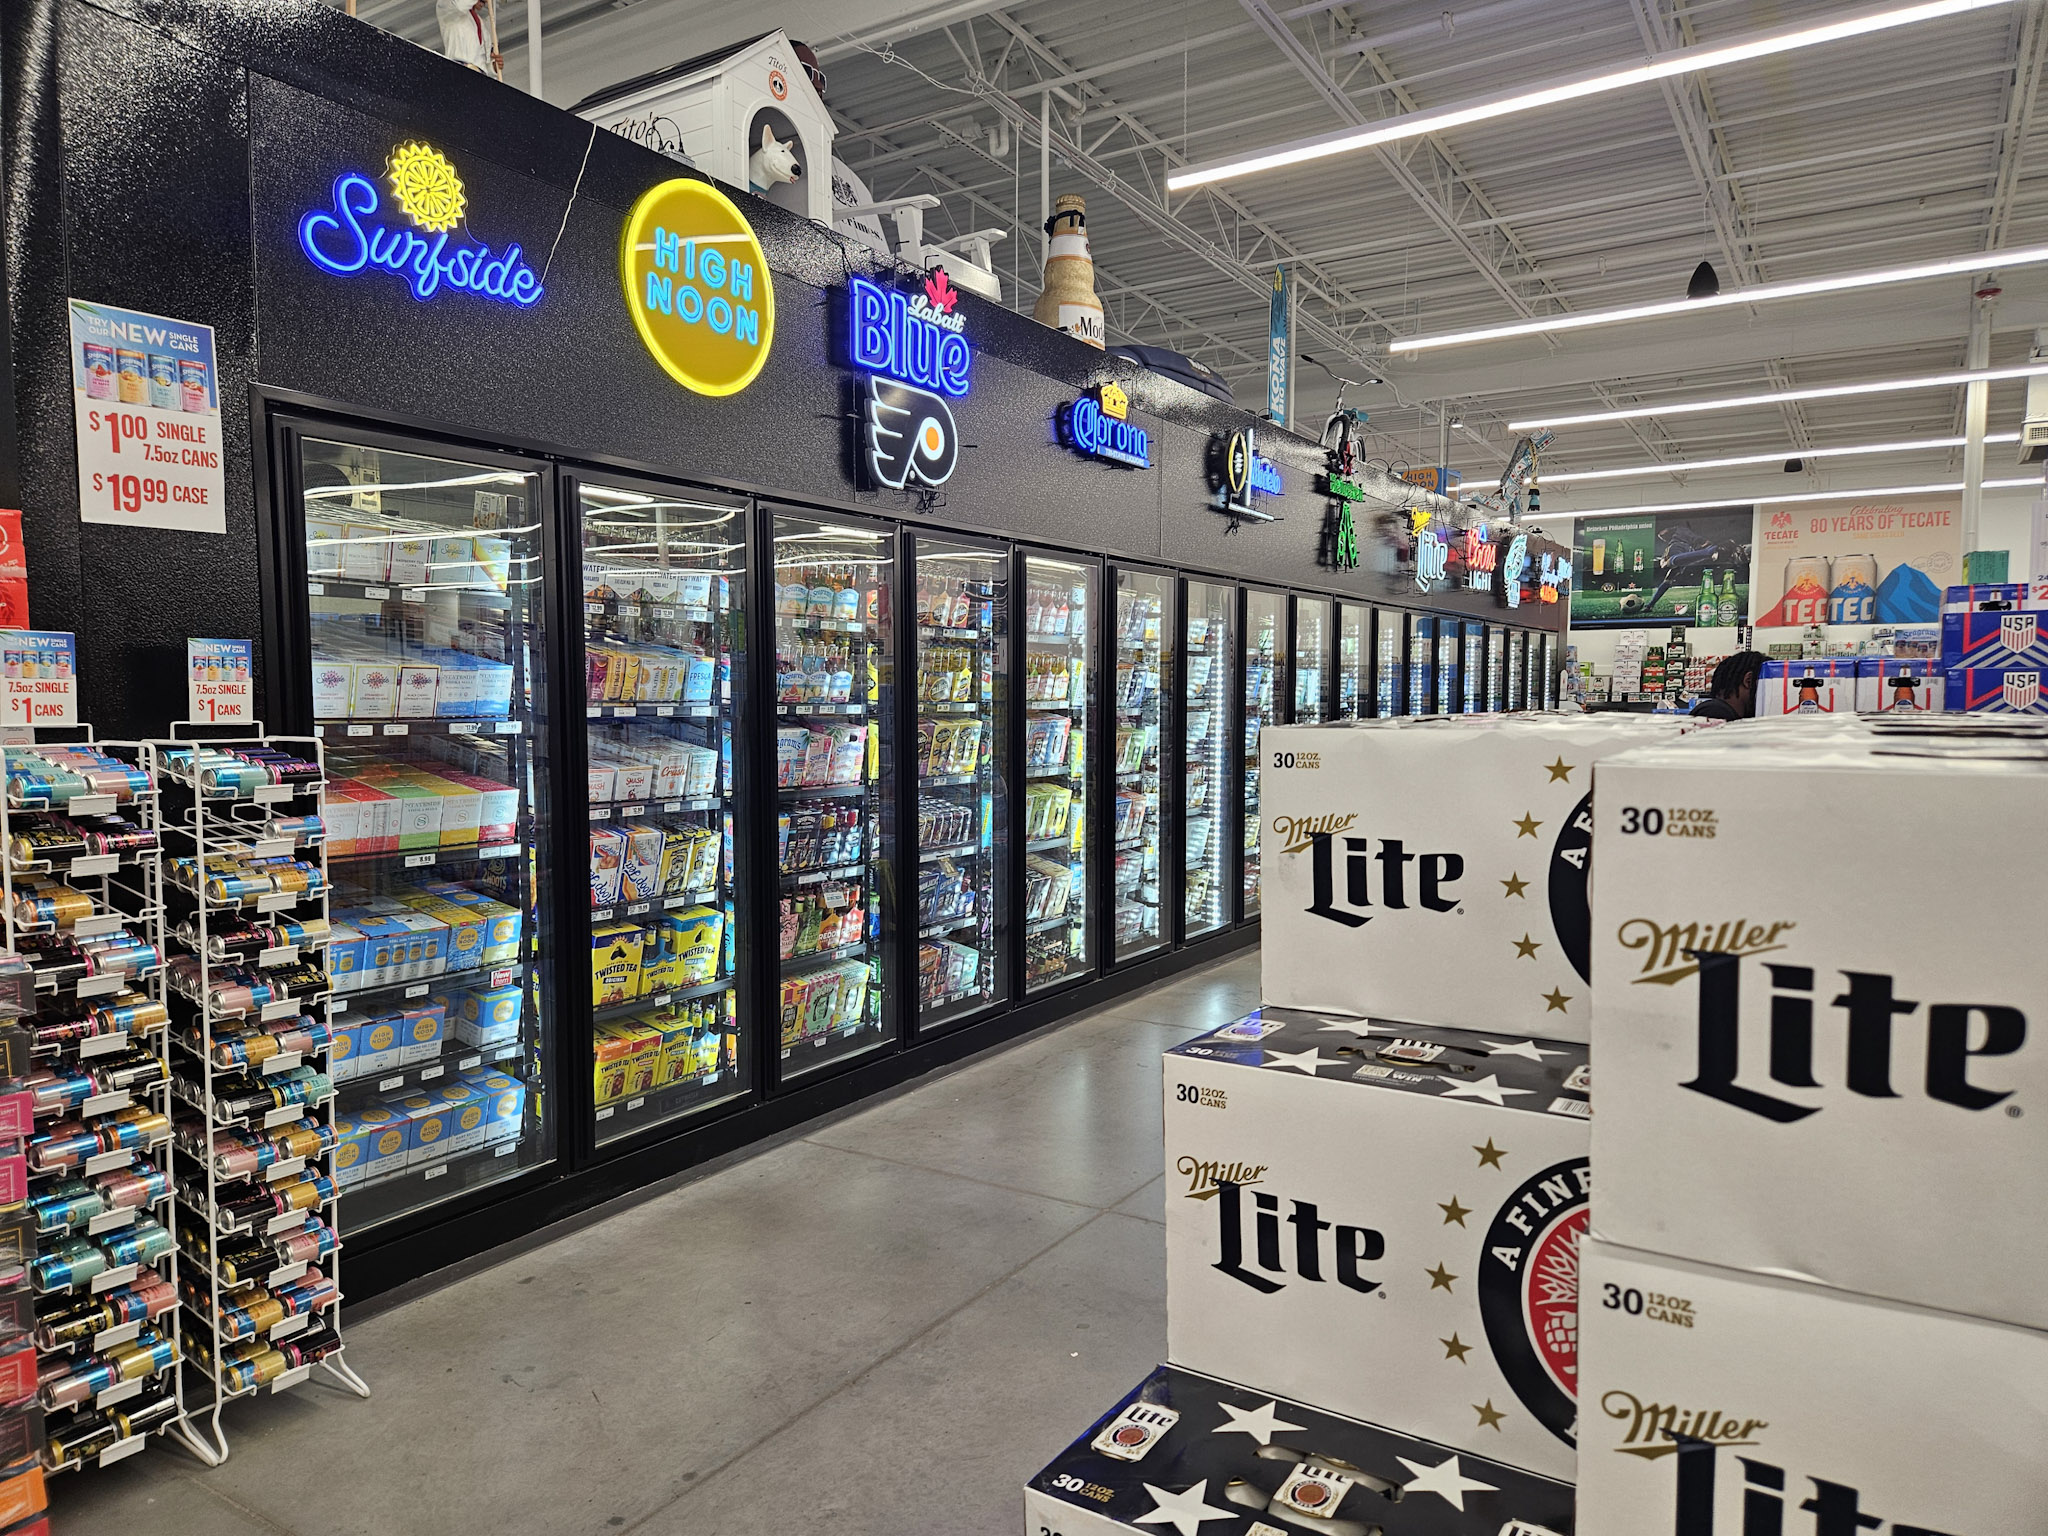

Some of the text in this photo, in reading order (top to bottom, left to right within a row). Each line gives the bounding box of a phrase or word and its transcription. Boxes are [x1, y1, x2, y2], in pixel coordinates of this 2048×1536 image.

[304, 176, 544, 305] Surfside
[655, 226, 753, 302] HIGH
[646, 272, 759, 347] NOON
[908, 294, 967, 334] Labatt
[88, 316, 108, 326] TRY
[88, 326, 109, 337] OUR
[110, 319, 167, 347] NEW
[169, 332, 199, 344] SINGLE
[852, 277, 971, 397] Blue
[169, 341, 199, 354] CANS
[1270, 336, 1282, 414] KONA
[1278, 336, 1287, 415] BIG WAVE
[157, 421, 207, 444] SINGLE
[1073, 397, 1149, 460] Corona
[143, 443, 219, 469] 7.5oz CANS
[1407, 472, 1432, 481] HIGH
[1414, 479, 1434, 488] OON
[172, 485, 209, 505] CASE
[1850, 505, 1904, 516] Celebrating
[1810, 510, 1951, 533] 80 YEARS OF TECATE
[1764, 529, 1799, 540] TECATE
[1469, 570, 1492, 592] LIGHT
[2003, 616, 2035, 631] USA
[18, 637, 50, 648] NEW
[205, 643, 232, 654] NEW
[8, 681, 69, 694] 7.5oz SINGLE
[196, 683, 246, 696] 7.5oz SINGLE
[2006, 674, 2037, 688] USA
[35, 703, 64, 717] CANS
[217, 704, 241, 717] CANS
[1273, 752, 1295, 769] 30
[1295, 760, 1321, 770] CANS
[661, 765, 686, 778] Crush
[1621, 807, 1664, 835] 30
[1273, 812, 1359, 854] Miller
[1666, 823, 1717, 840] CANS
[1560, 846, 1588, 870] A
[1304, 831, 1465, 928] Lite
[678, 946, 705, 962] TWISTED
[1618, 917, 1797, 987] Miller
[493, 971, 512, 979] New
[594, 963, 638, 980] TWISTED TEA
[665, 966, 674, 974] TEA
[374, 1031, 391, 1039] HIGH
[416, 1028, 434, 1036] NOON
[417, 1023, 434, 1031] HIGH
[1677, 948, 2027, 1124] Lite
[664, 1041, 684, 1054] TWISTED
[631, 1051, 653, 1064] TWISTED
[601, 1060, 622, 1074] TWISTED
[1176, 1083, 1199, 1104] 30
[1200, 1097, 1227, 1110] CANS
[421, 1129, 440, 1138] NOON
[423, 1124, 439, 1133] HIGH
[380, 1142, 399, 1150] NOON
[1177, 1155, 1269, 1201] Miller
[1210, 1176, 1386, 1294] Lite
[1491, 1242, 1522, 1272] A
[1602, 1282, 1644, 1316] 30
[1646, 1306, 1696, 1329] CANS
[1125, 1405, 1175, 1428] Lite
[1601, 1389, 1770, 1461] Miller
[1051, 1473, 1085, 1492] 30
[1657, 1427, 1962, 1536] Lit
[1079, 1488, 1112, 1504] CANS
